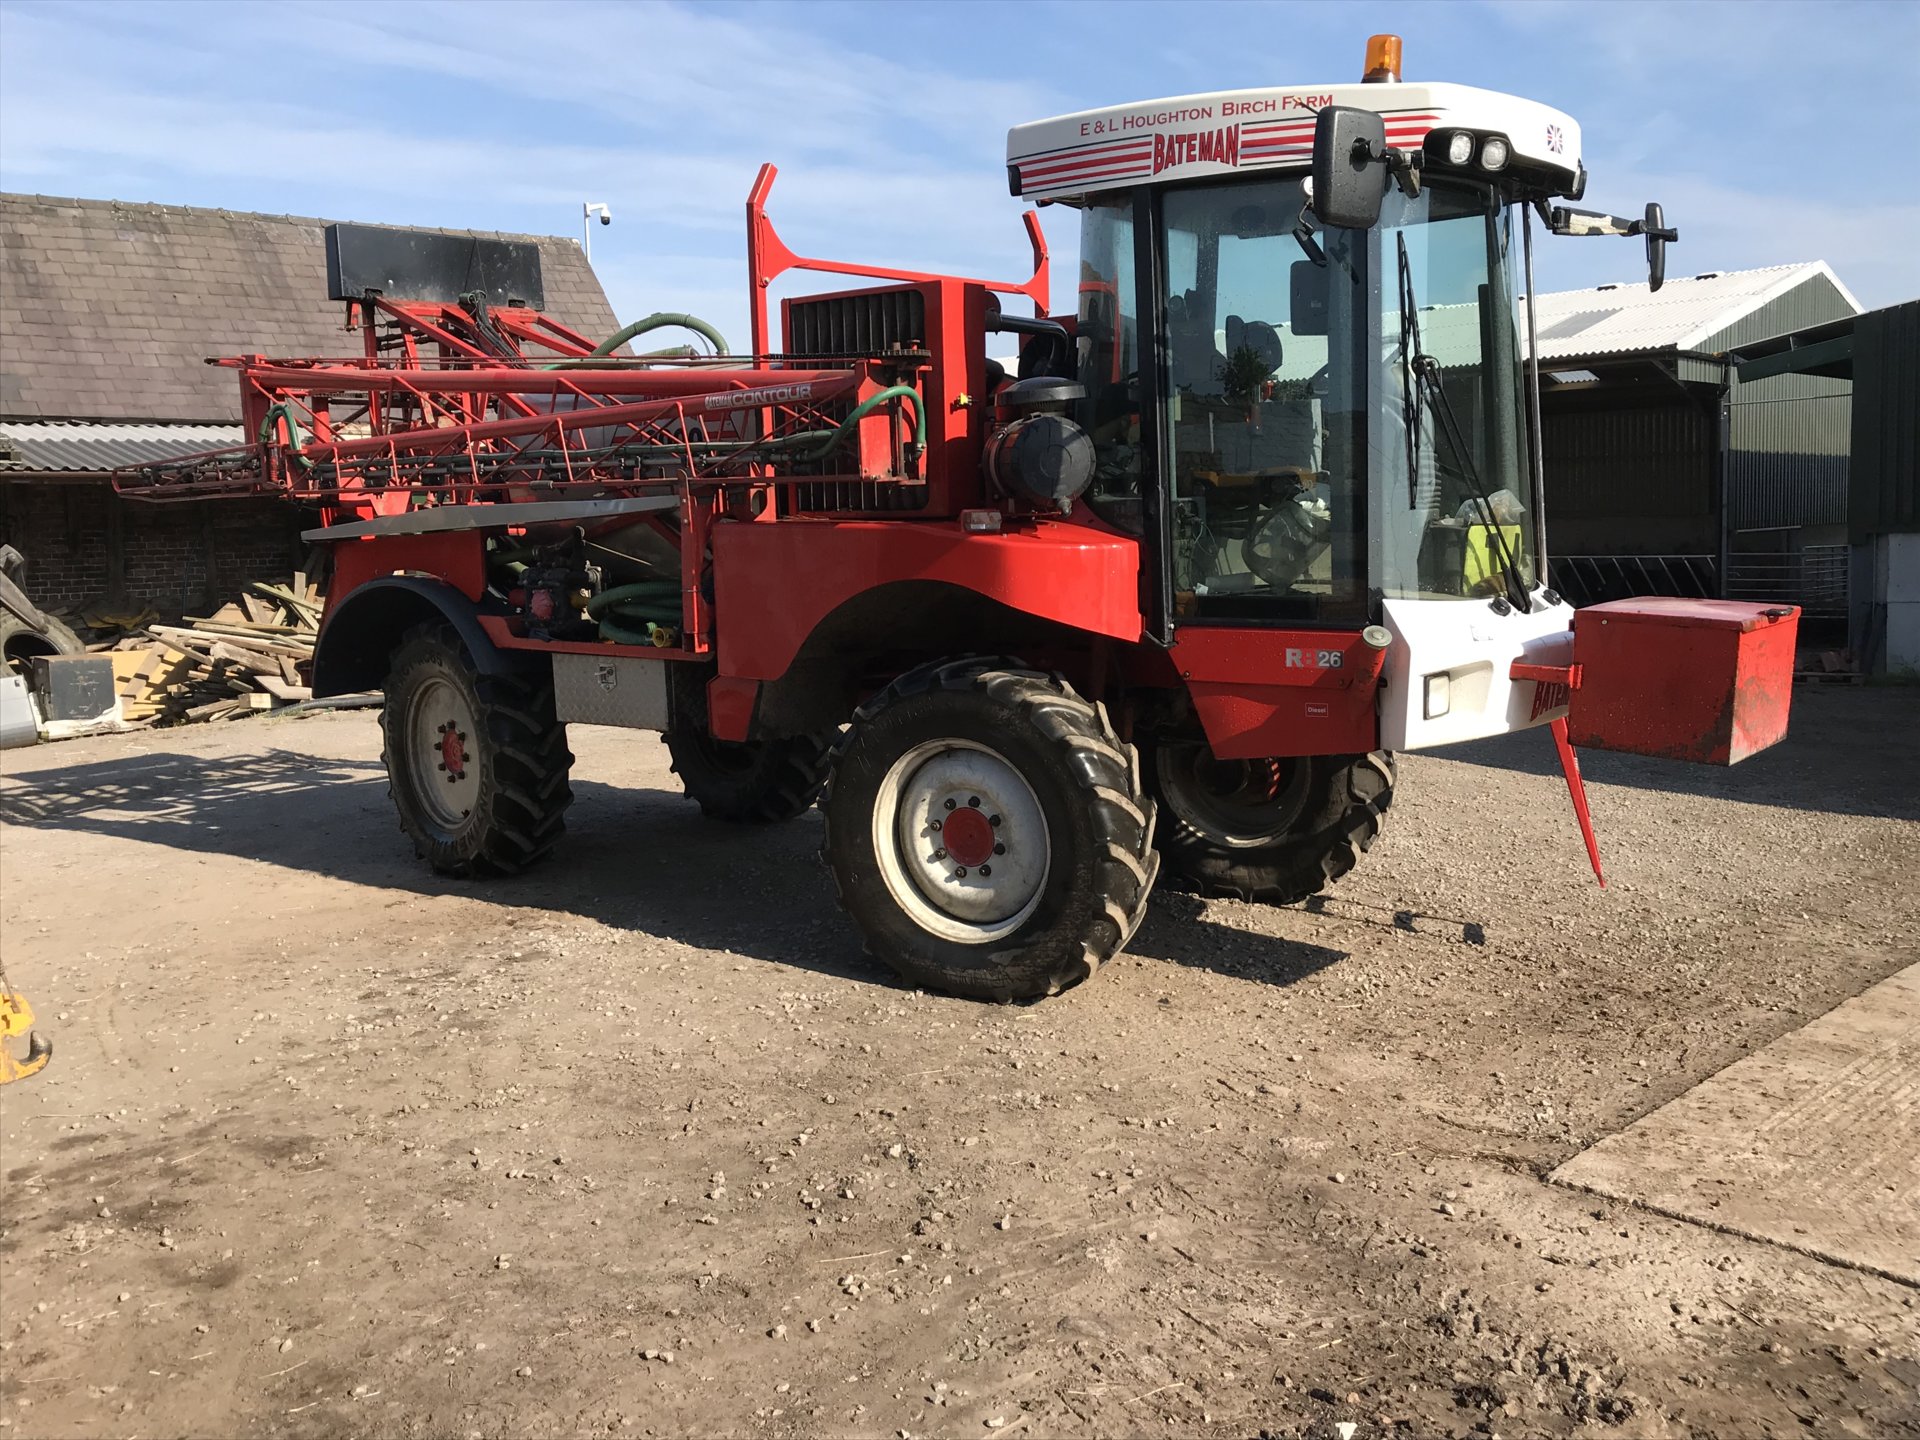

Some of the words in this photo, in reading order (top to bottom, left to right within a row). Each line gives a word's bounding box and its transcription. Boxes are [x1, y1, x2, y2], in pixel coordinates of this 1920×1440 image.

[1080, 122, 1091, 136] E
[1094, 120, 1105, 134] &
[1109, 118, 1119, 132] L
[1123, 106, 1212, 129] HOUGHTON
[1222, 99, 1276, 116] BIRCH
[1282, 95, 1333, 109] FARM
[1153, 122, 1240, 176] BATEMAN
[732, 384, 812, 408] CONTOUR
